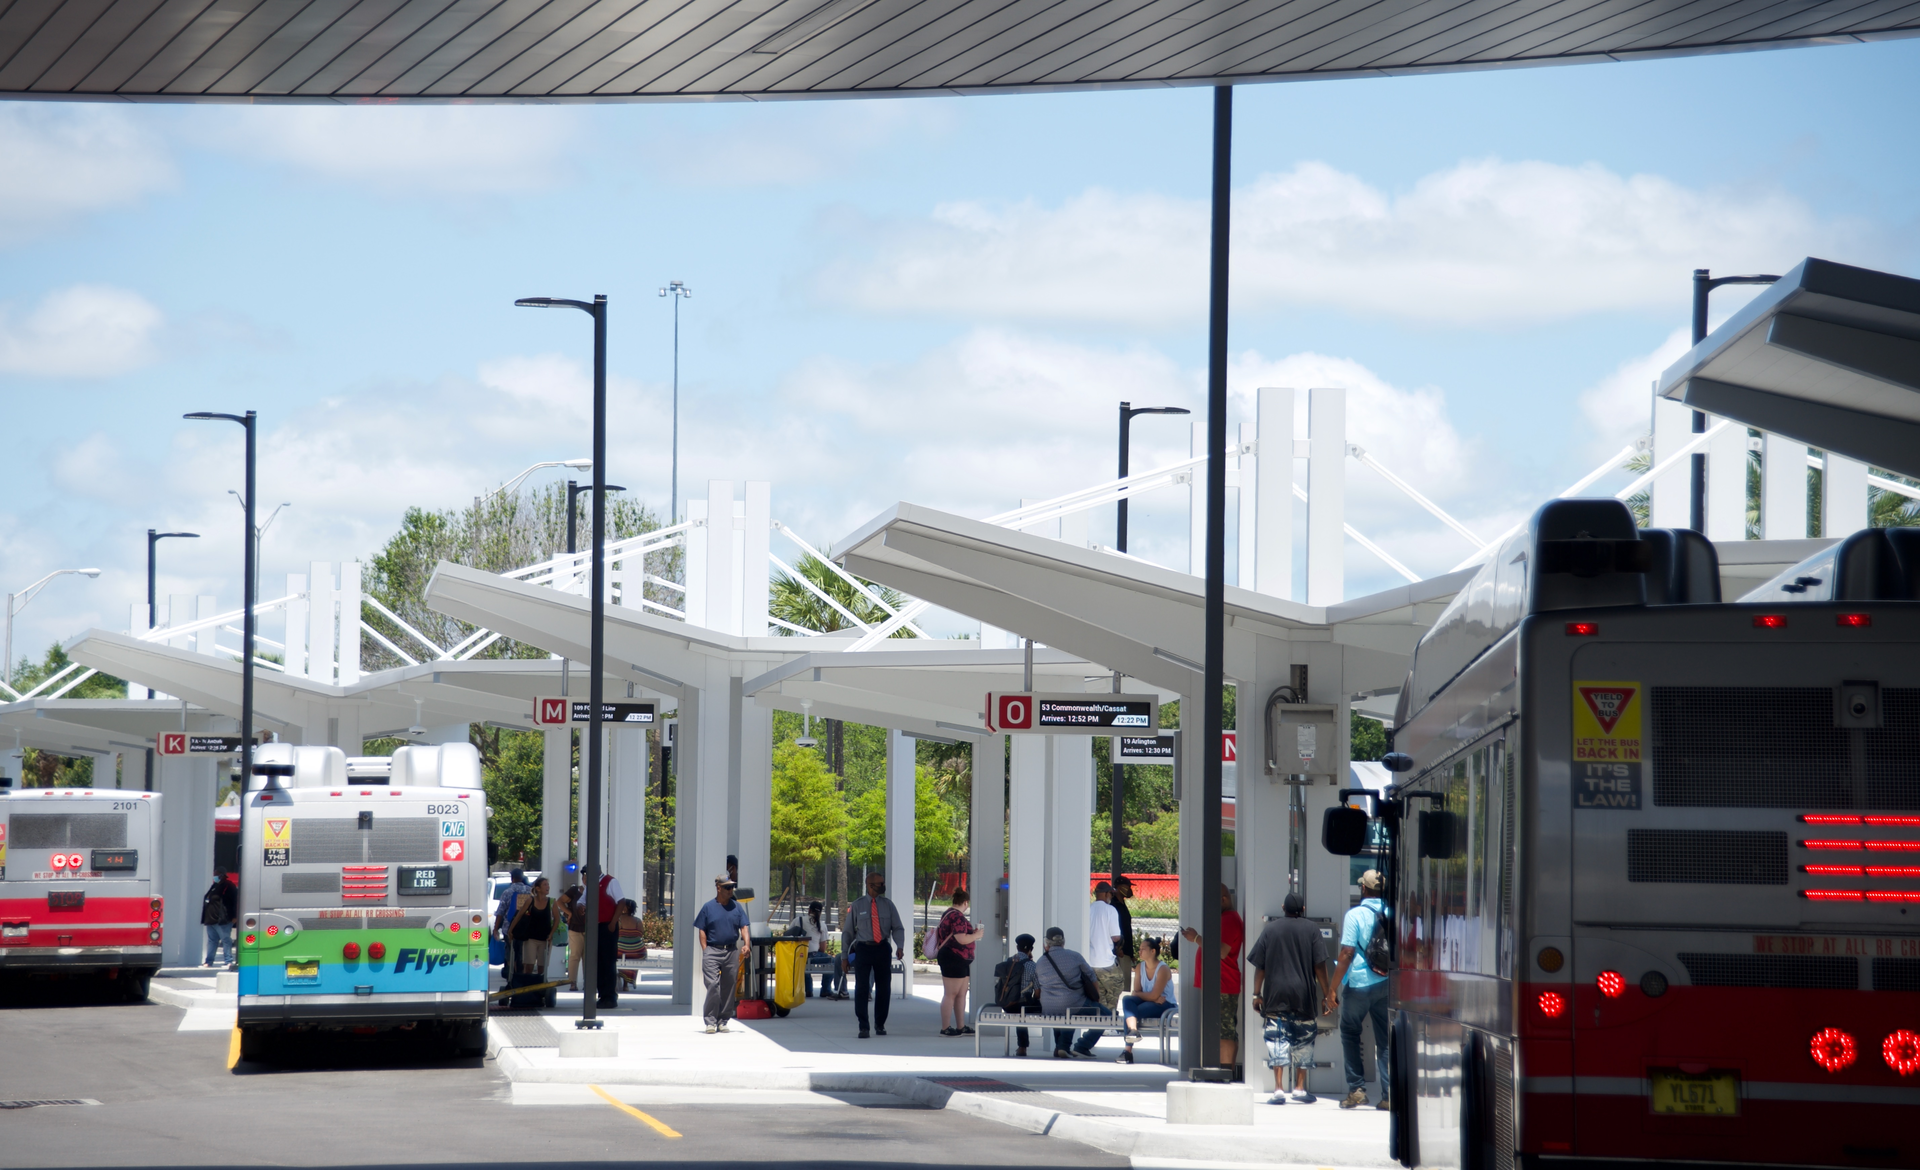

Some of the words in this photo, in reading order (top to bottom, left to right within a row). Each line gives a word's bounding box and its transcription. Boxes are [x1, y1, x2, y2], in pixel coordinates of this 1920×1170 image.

[546, 703, 562, 720] M
[1006, 700, 1025, 724] O
[1052, 704, 1127, 712] Commonwealth/Cassat
[169, 737, 181, 751] K
[1225, 738, 1236, 757] N
[1577, 747, 1618, 759] BACK
[1624, 748, 1639, 759] IN
[1587, 764, 1629, 776] IT'S
[1585, 779, 1631, 791] THE
[1579, 794, 1636, 807] LAW!
[428, 804, 459, 814] B023
[442, 822, 464, 836] CNG
[416, 870, 435, 878] RED
[414, 879, 437, 887] LINE
[52, 892, 82, 905] STOP
[1756, 936, 1774, 953] WE
[1782, 936, 1814, 954] STOP
[1822, 937, 1837, 954] AT
[1845, 938, 1868, 955] ALL
[1876, 939, 1892, 956] RR
[393, 948, 458, 974] Flyer
[1670, 1083, 1716, 1104] YL671
